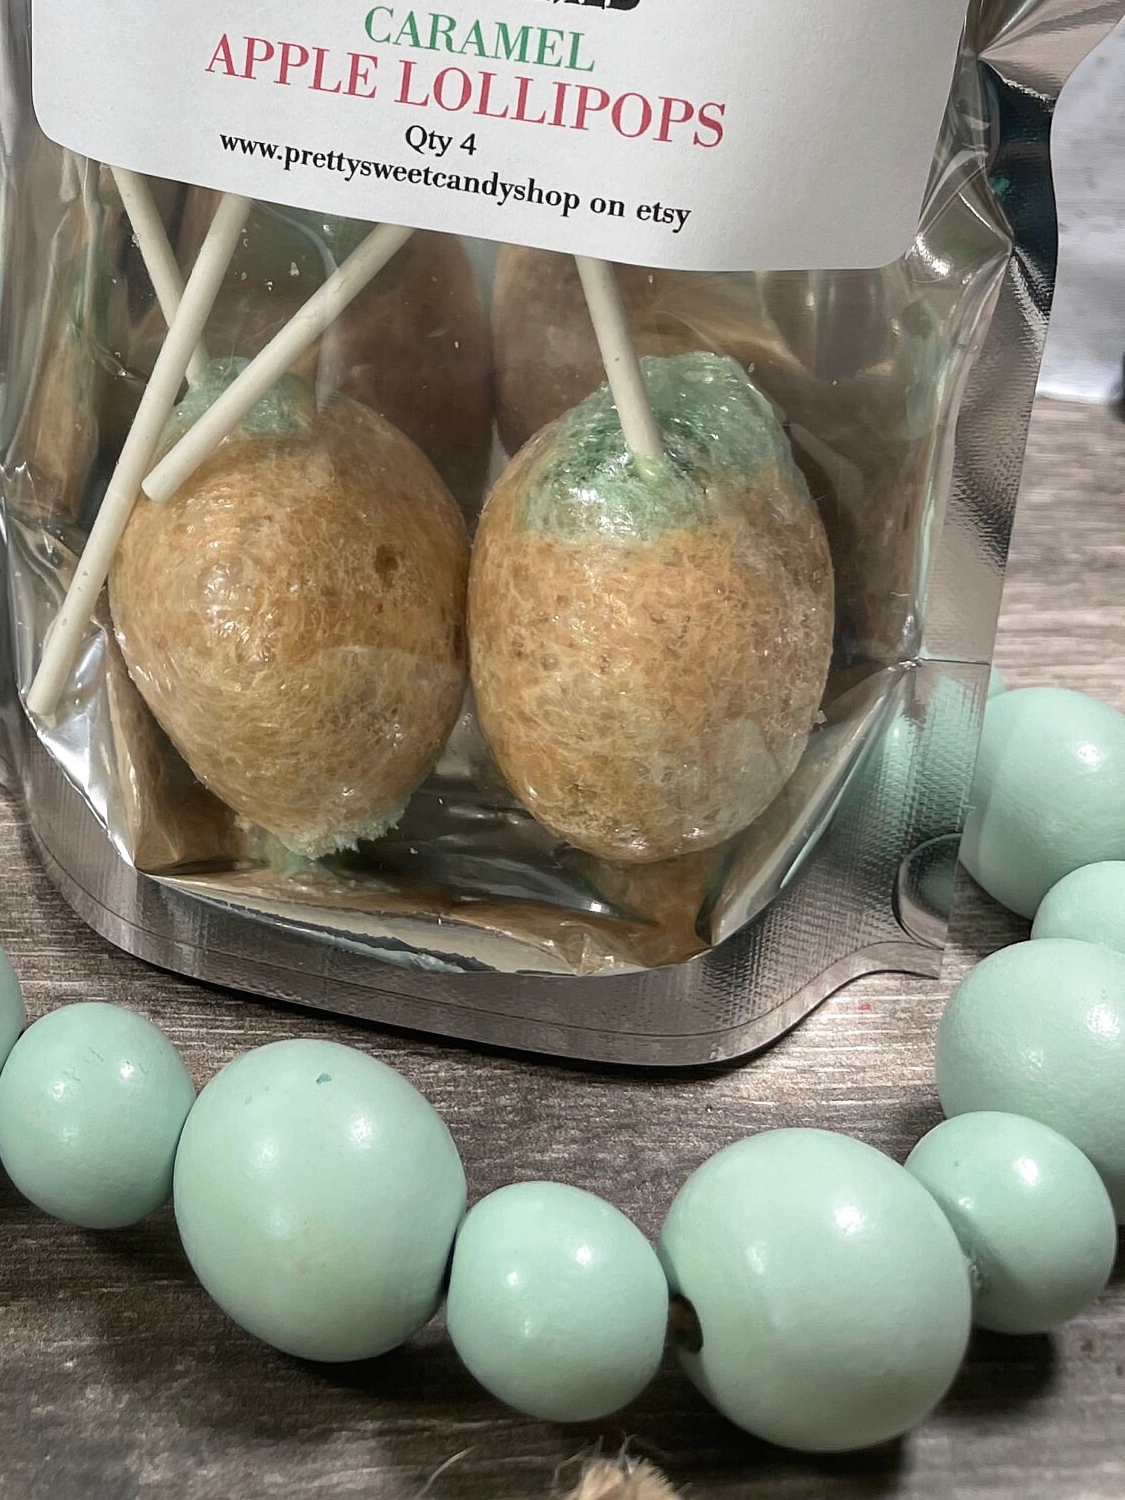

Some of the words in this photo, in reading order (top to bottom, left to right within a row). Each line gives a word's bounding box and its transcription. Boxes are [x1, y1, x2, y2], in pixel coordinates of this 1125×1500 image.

[363, 5, 596, 73] CARAMEL
[204, 32, 379, 99] APPLE
[393, 58, 726, 149] LOLLIPOPS
[404, 124, 454, 158] Qty
[459, 132, 477, 156] 4
[219, 133, 580, 217] www.prettysweetcandyshop
[589, 197, 626, 218] on
[636, 201, 693, 234] etsy
